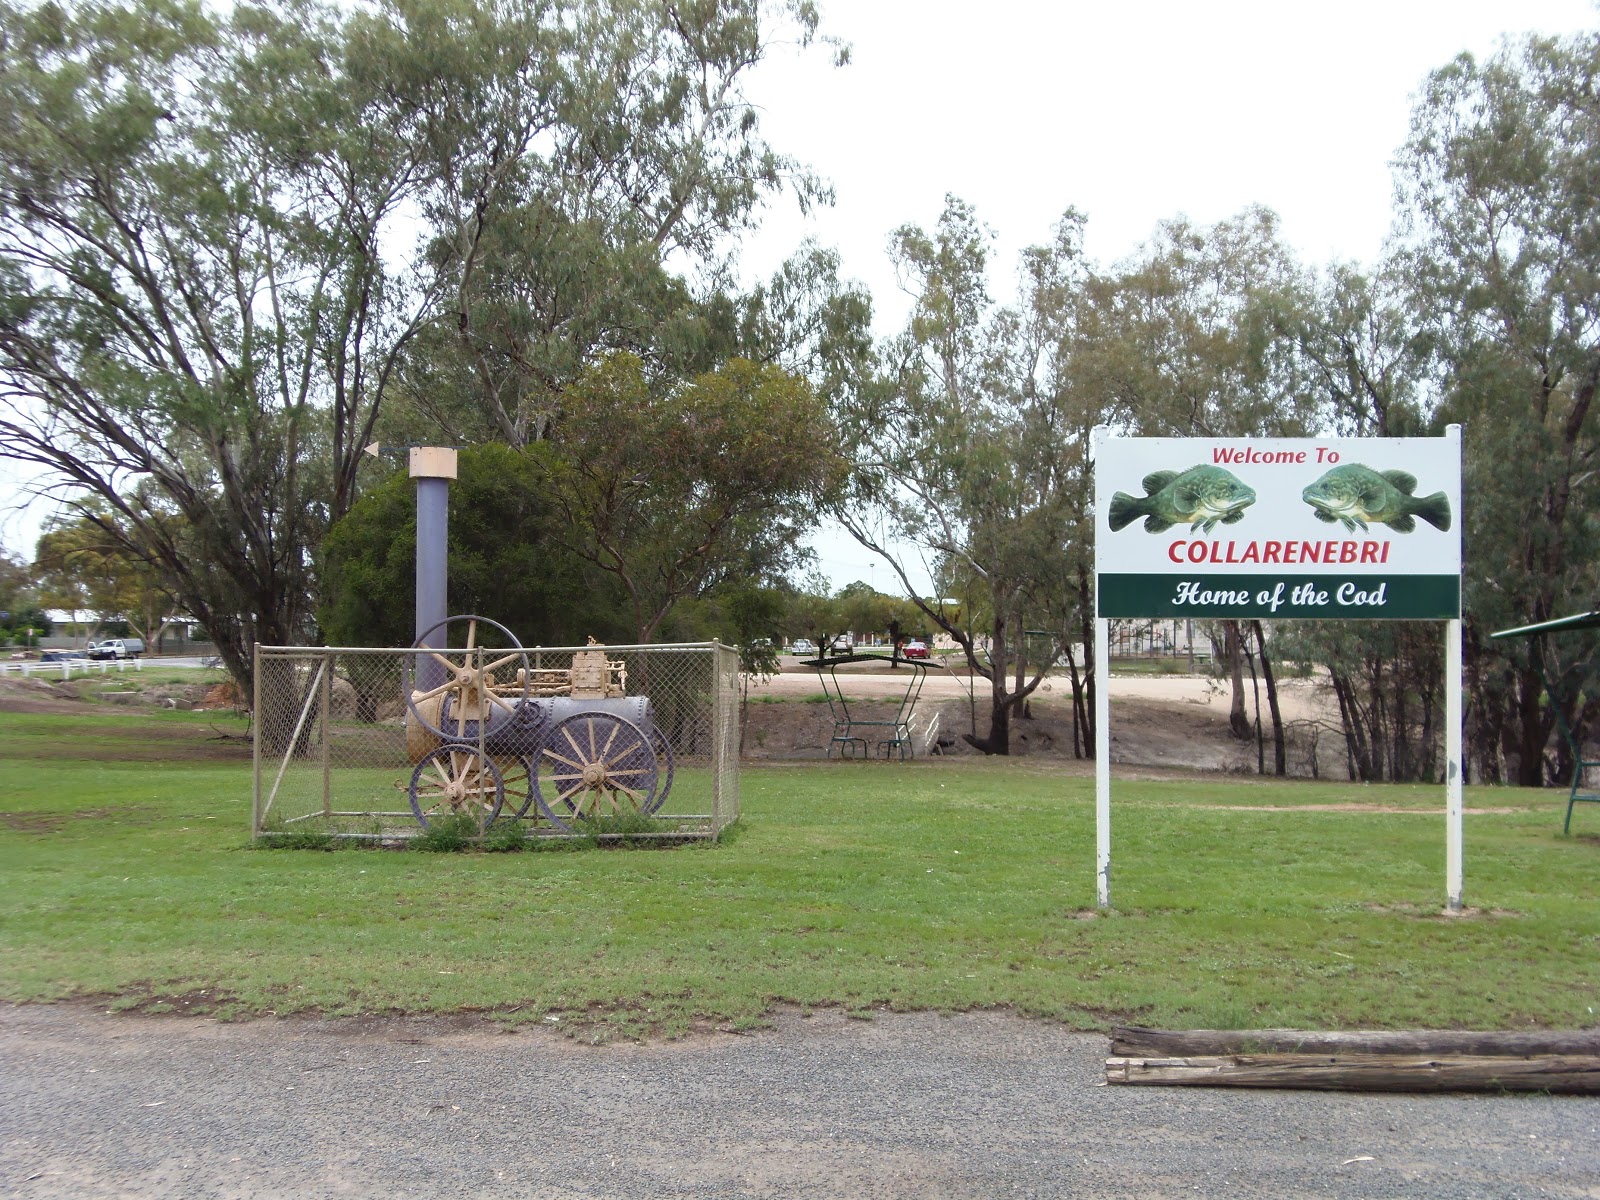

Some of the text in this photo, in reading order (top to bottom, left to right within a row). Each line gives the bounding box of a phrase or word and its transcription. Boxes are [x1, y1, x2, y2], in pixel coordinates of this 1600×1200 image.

[1213, 446, 1340, 464] Welcome To
[1168, 540, 1391, 564] COLLARENEBRI
[1171, 581, 1387, 612] Home of the Cod
